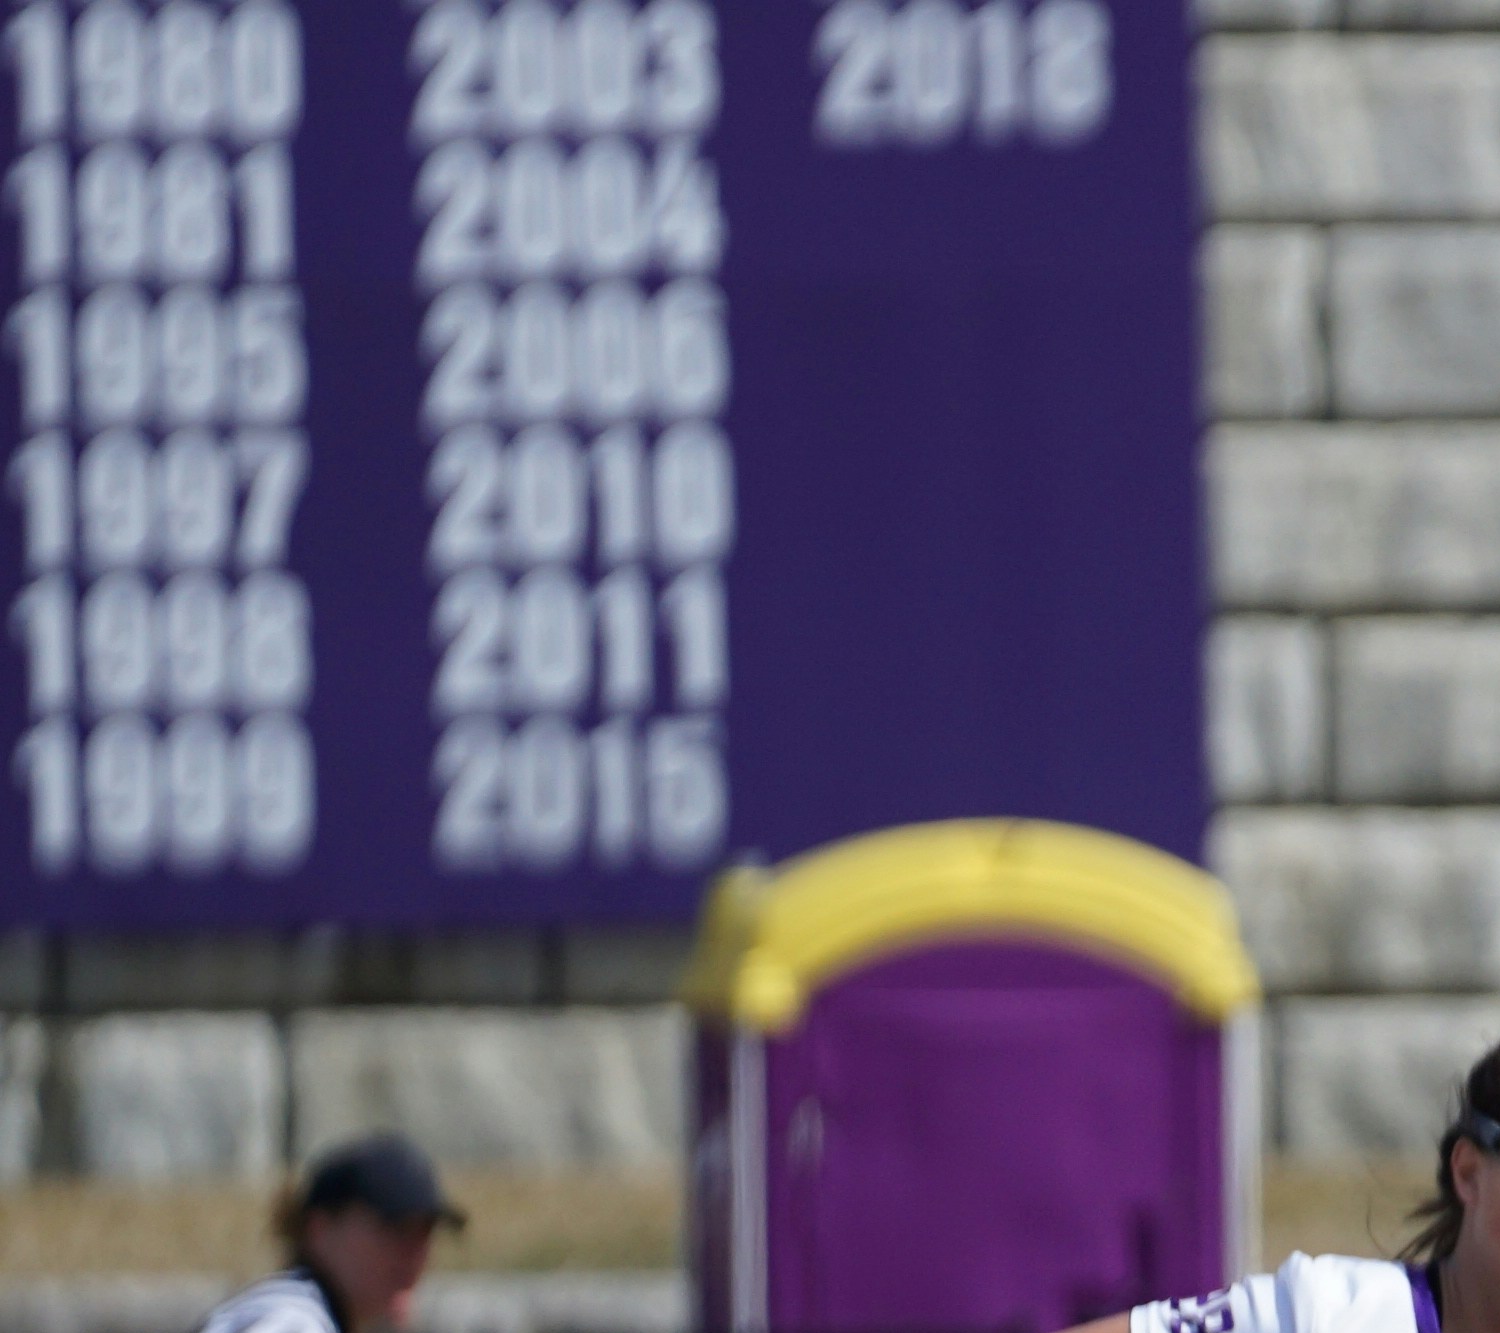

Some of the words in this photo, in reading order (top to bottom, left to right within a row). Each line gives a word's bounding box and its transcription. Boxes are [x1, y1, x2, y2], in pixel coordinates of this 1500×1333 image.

[6, 0, 300, 142] 1980
[416, 0, 718, 140] 2003
[822, 0, 1107, 136] 2018
[9, 143, 292, 284] 1981
[420, 141, 722, 282] 2004
[10, 284, 304, 428] 1995
[13, 428, 305, 570] 1997
[431, 427, 732, 570] 2010
[437, 571, 726, 713] 2011
[18, 716, 312, 866] 1999
